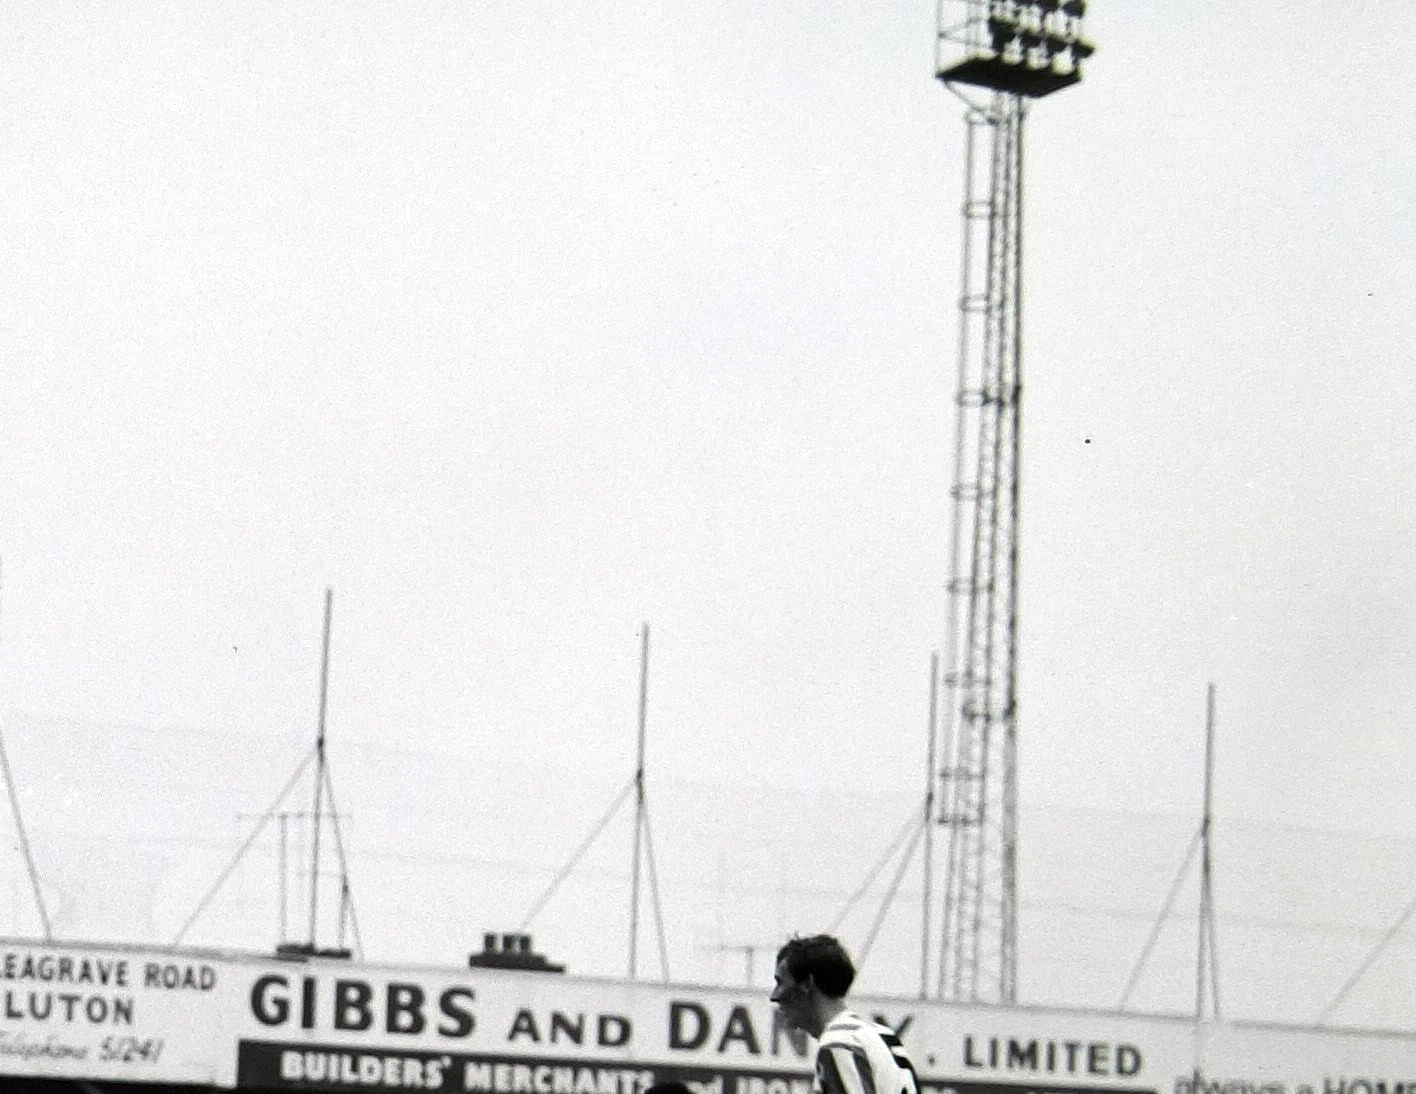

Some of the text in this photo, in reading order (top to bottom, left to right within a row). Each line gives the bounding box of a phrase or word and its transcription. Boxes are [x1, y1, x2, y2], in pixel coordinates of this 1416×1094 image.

[144, 962, 216, 991] ROAD
[5, 990, 134, 1025] LUTON
[250, 974, 477, 1039] GIBBS
[507, 1008, 632, 1048] AND
[963, 1035, 1143, 1077] LIMITED
